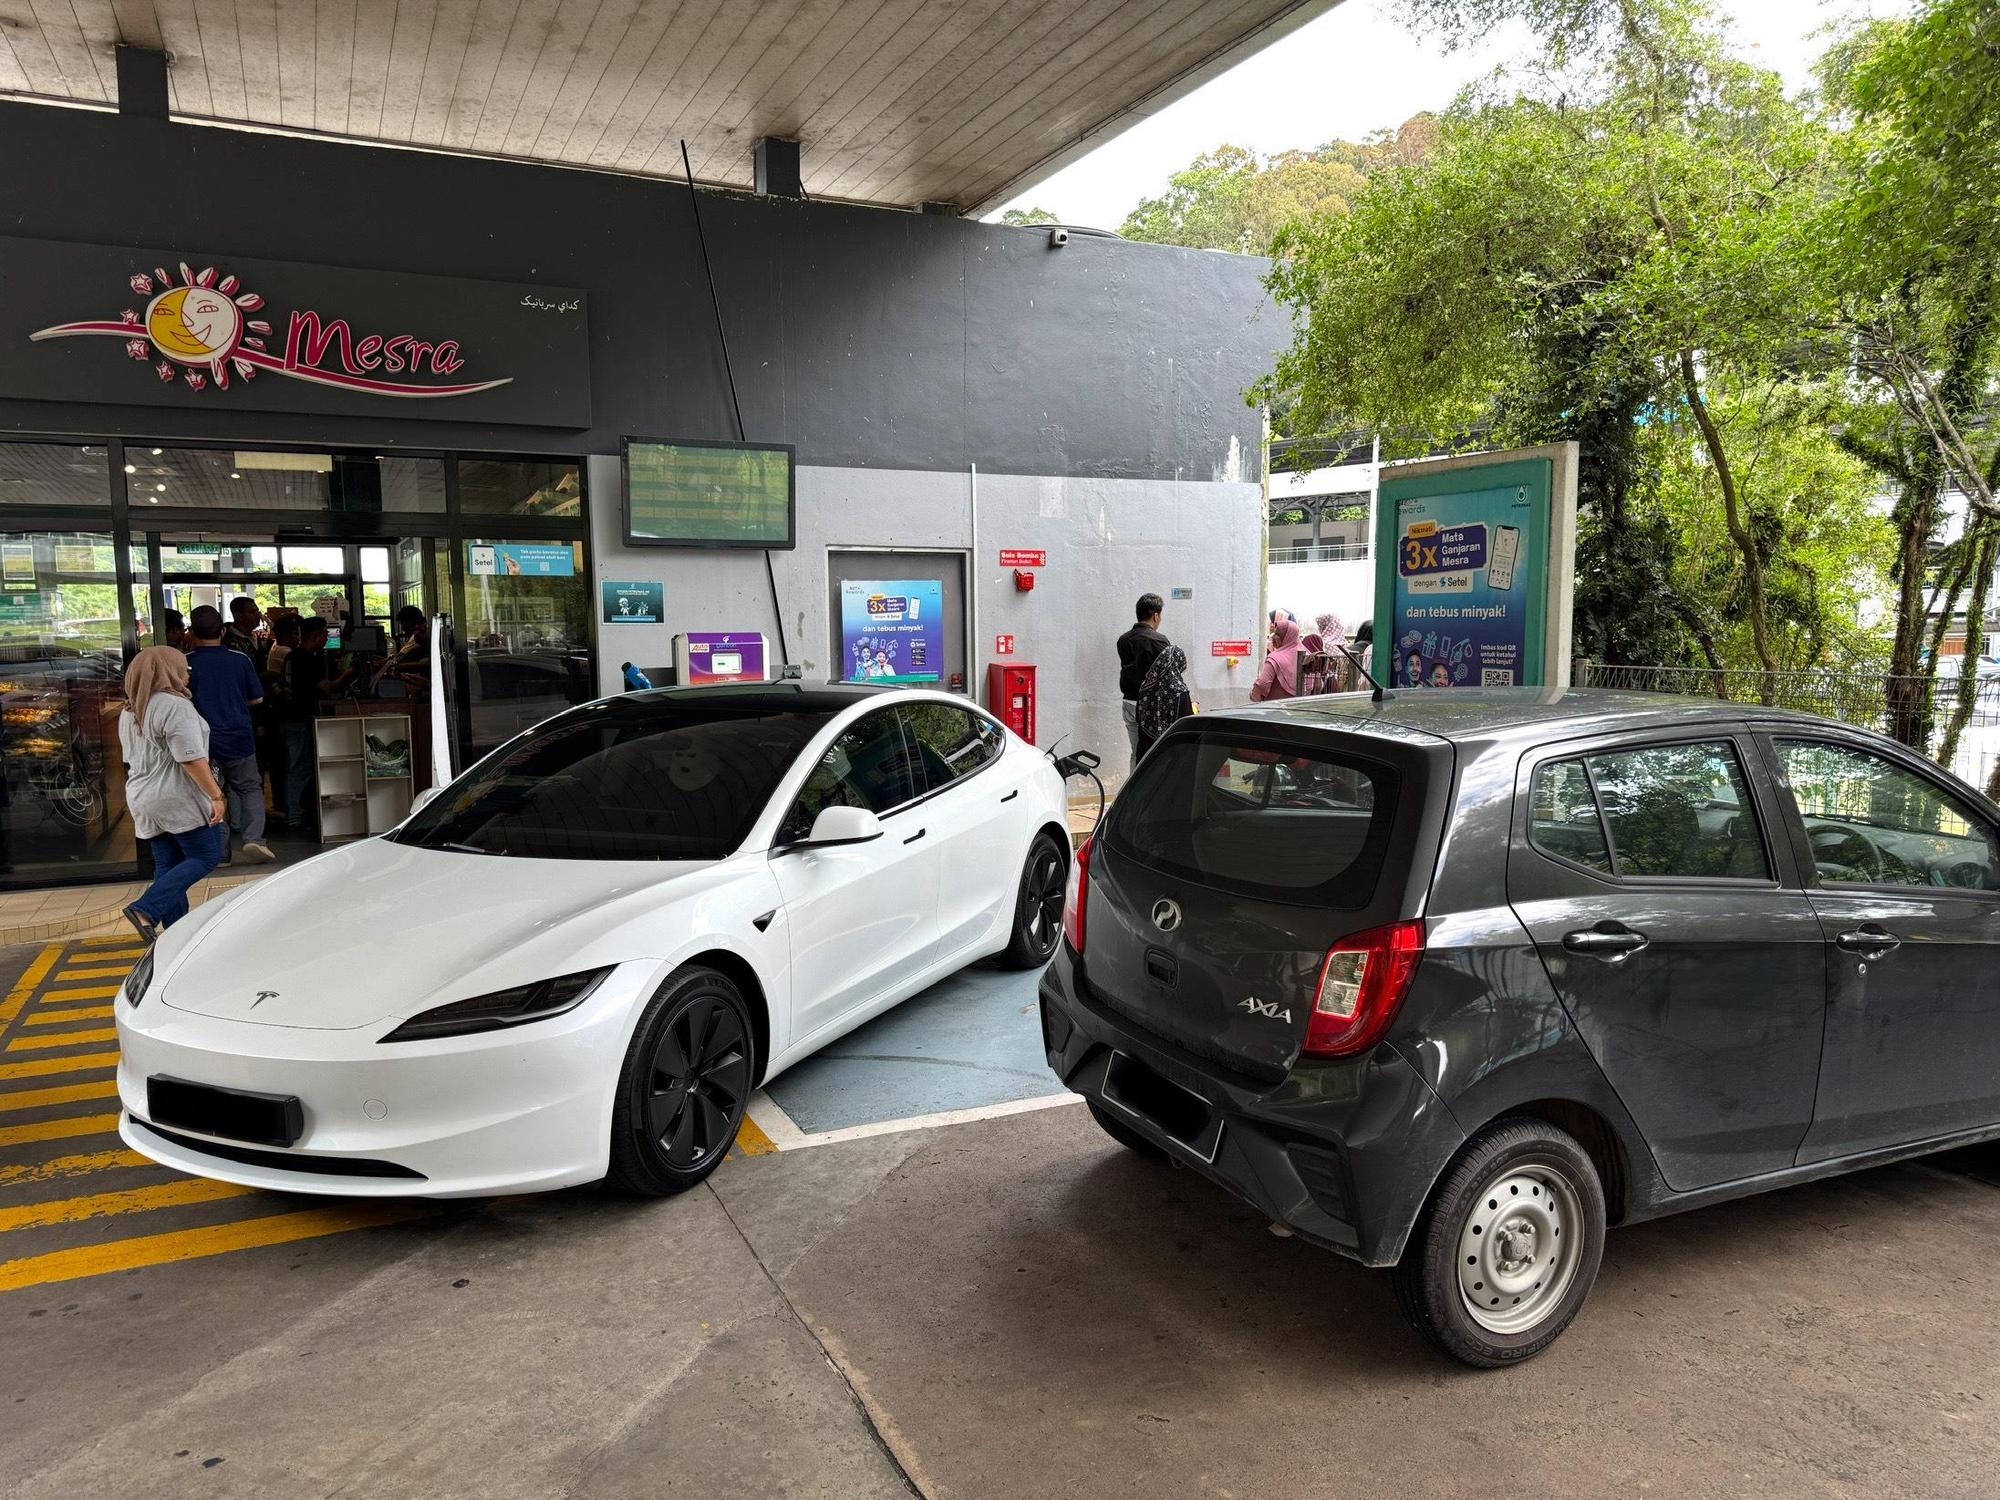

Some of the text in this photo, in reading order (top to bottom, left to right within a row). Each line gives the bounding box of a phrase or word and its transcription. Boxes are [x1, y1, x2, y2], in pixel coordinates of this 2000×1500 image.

[284, 310, 465, 375] Mesra
[1442, 532, 1464, 544] Mata
[1406, 540, 1438, 570] 3x
[1442, 542, 1480, 556] Ganjaran
[1442, 556, 1469, 567] Mesra
[1414, 576, 1468, 588] dengan Setel
[870, 600, 886, 612] 3x
[1406, 604, 1506, 620] dan tebus minyak!
[863, 624, 924, 632] dan tebus minyak!
[1237, 996, 1292, 1024] AXIA
